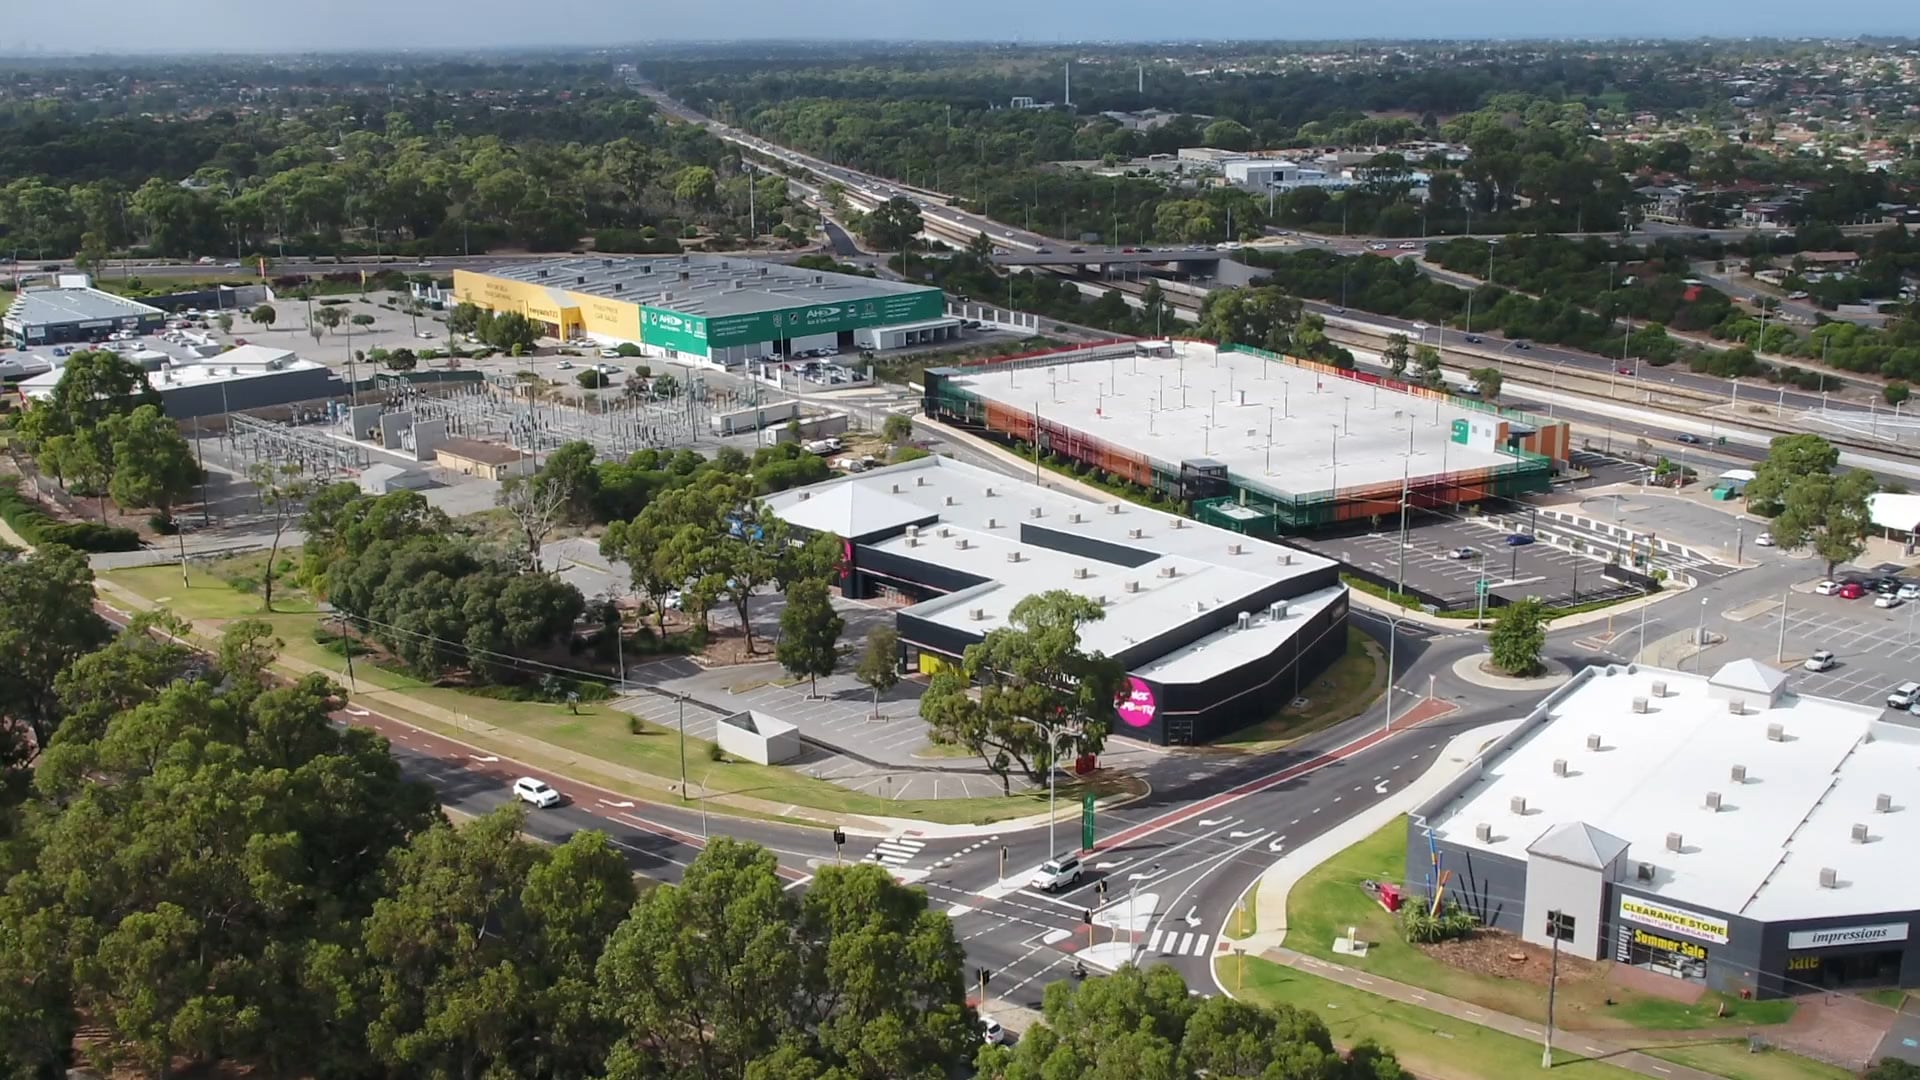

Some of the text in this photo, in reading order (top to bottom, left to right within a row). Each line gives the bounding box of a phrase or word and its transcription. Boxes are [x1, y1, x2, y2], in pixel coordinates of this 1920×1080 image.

[1623, 902, 1725, 936] CLEARANCE STORE
[1630, 913, 1715, 941] FURNITURE BARGAINS
[1635, 928, 1680, 952] Summer
[1681, 941, 1705, 959] Sale
[1812, 928, 1888, 944] impressions
